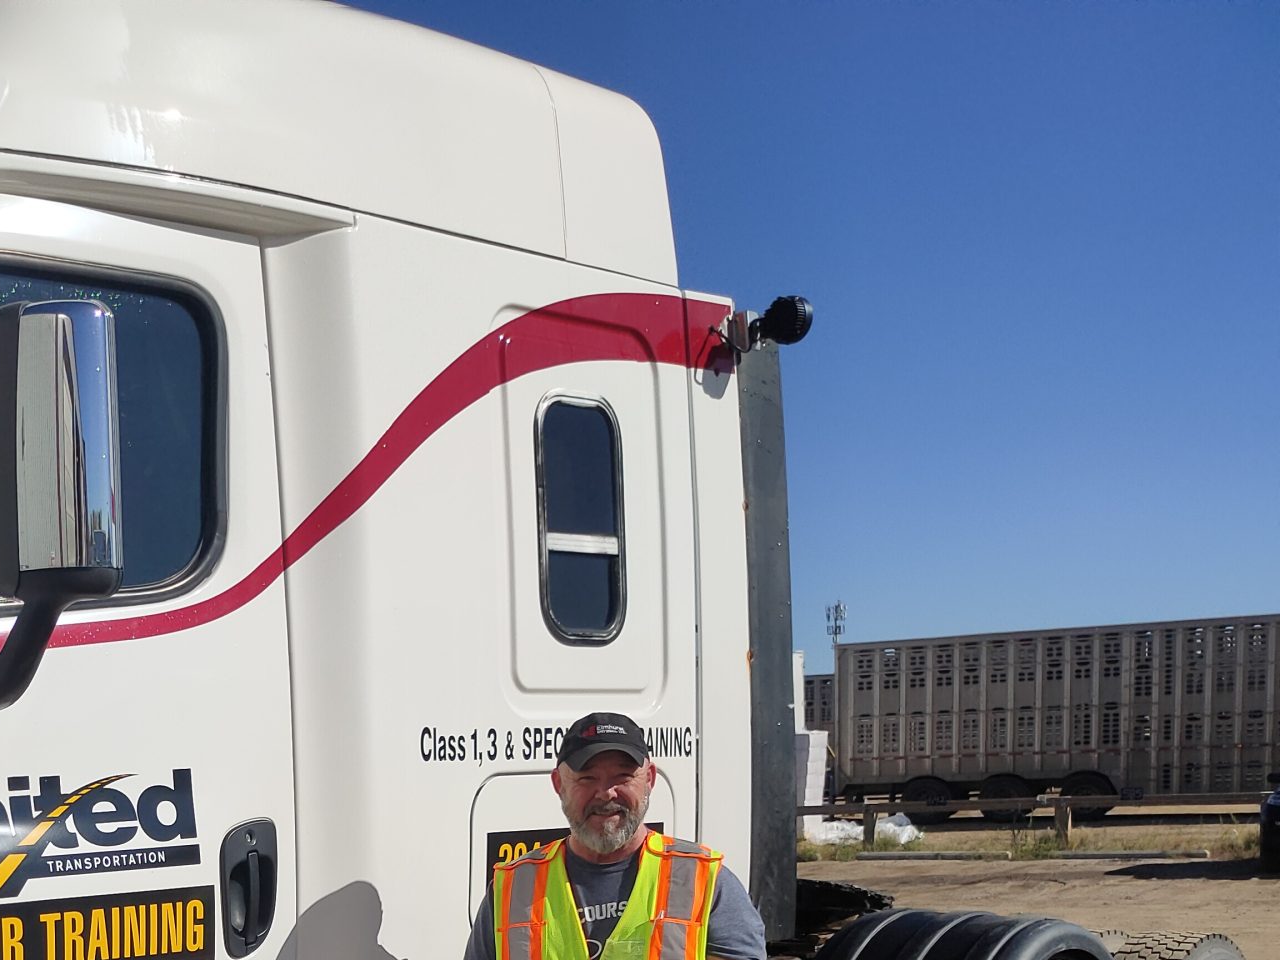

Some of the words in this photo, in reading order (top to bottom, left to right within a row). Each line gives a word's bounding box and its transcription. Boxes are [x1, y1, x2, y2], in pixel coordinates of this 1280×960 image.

[420, 727, 466, 761] Class
[505, 731, 515, 760] &
[522, 727, 569, 760] SPEC
[639, 727, 692, 757] AINING
[47, 850, 167, 873] TRANSPORTATION
